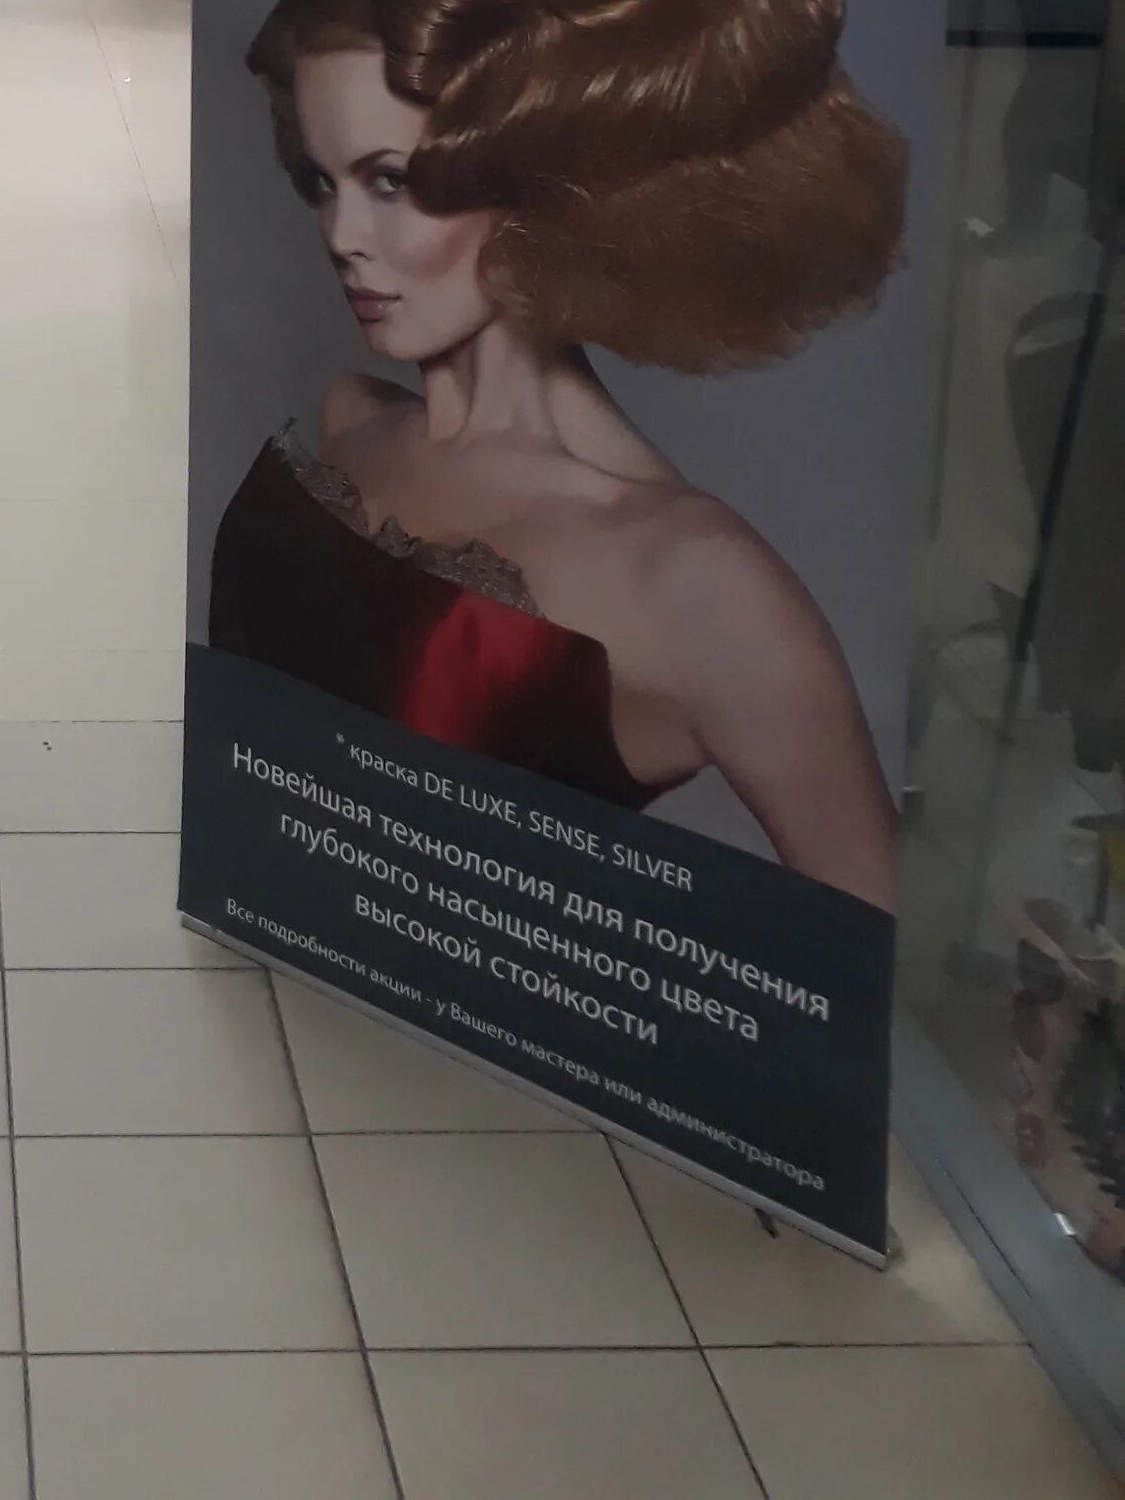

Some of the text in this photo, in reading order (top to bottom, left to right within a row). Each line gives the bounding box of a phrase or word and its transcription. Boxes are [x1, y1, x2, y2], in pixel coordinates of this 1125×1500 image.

[233, 741, 829, 1022] Новейшая технология для получения
[280, 813, 759, 1042] глубокого насыщенного цвета
[350, 743, 693, 892] краска DE LUXE, SENSE, SILVER
[227, 898, 255, 924] Все
[259, 916, 366, 977] подробности
[370, 969, 422, 1003] акции
[434, 999, 446, 1017] у
[451, 1002, 517, 1047] Вашего
[522, 1038, 600, 1085] мастера
[604, 1077, 642, 1105] или
[647, 1096, 824, 1191] администратора
[355, 893, 658, 1046] высокой стойкости
